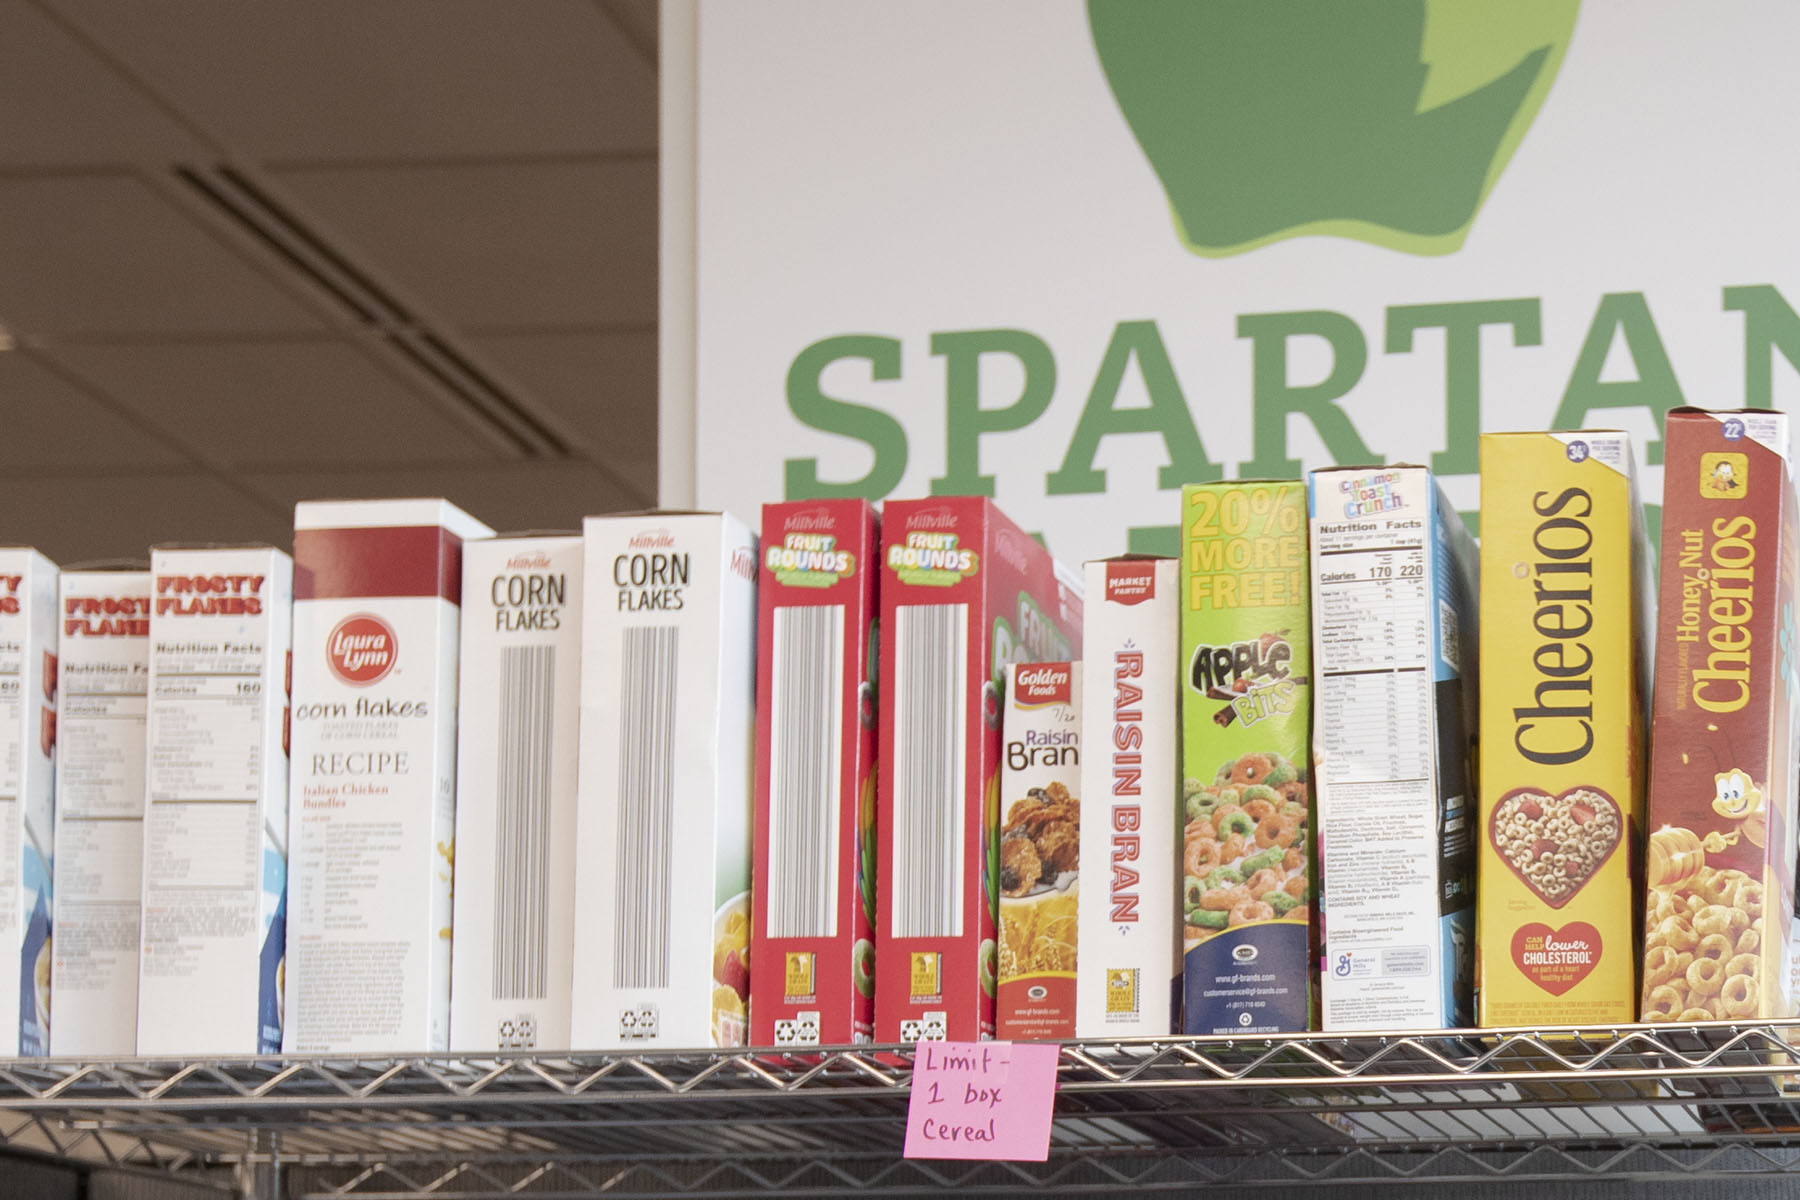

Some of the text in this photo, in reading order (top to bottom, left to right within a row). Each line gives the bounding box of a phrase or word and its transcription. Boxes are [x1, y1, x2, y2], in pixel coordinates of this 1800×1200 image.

[1340, 471, 1401, 493] Cinnamon
[1352, 484, 1391, 502] Toast
[1190, 487, 1298, 537] 20%
[1345, 493, 1402, 519] Crunch
[1320, 519, 1422, 534] Nutrition Facts
[786, 534, 832, 550] FRUIT
[909, 533, 955, 550] FRUIT
[767, 550, 849, 571] ROUNDS
[889, 549, 972, 571] ROUNDS
[1190, 536, 1300, 573] MORE
[613, 553, 690, 588] CORN
[491, 574, 566, 608] CORN
[1109, 577, 1152, 588] MARKET
[1190, 570, 1300, 611] FREE!
[1676, 528, 1708, 642] Honey Nut
[618, 588, 684, 611] FLAKES
[496, 608, 561, 632] FLAKES
[1692, 515, 1757, 714] Cheerios
[1513, 487, 1594, 766] Cheerios
[334, 631, 386, 656] Laura
[343, 650, 388, 672] Lynn
[1191, 641, 1291, 692] APPLE
[1018, 668, 1068, 686] Golden
[1028, 685, 1057, 696] Foods
[296, 697, 428, 720] corn flakes
[1026, 729, 1079, 745] Raisin
[312, 751, 410, 776] RECIPE
[1007, 741, 1079, 771] Bran
[1110, 650, 1144, 922] RAISIN BRAN
[1545, 934, 1590, 951] lower
[928, 1083, 1002, 1104] 1 box
[923, 1118, 995, 1142] Cereal
